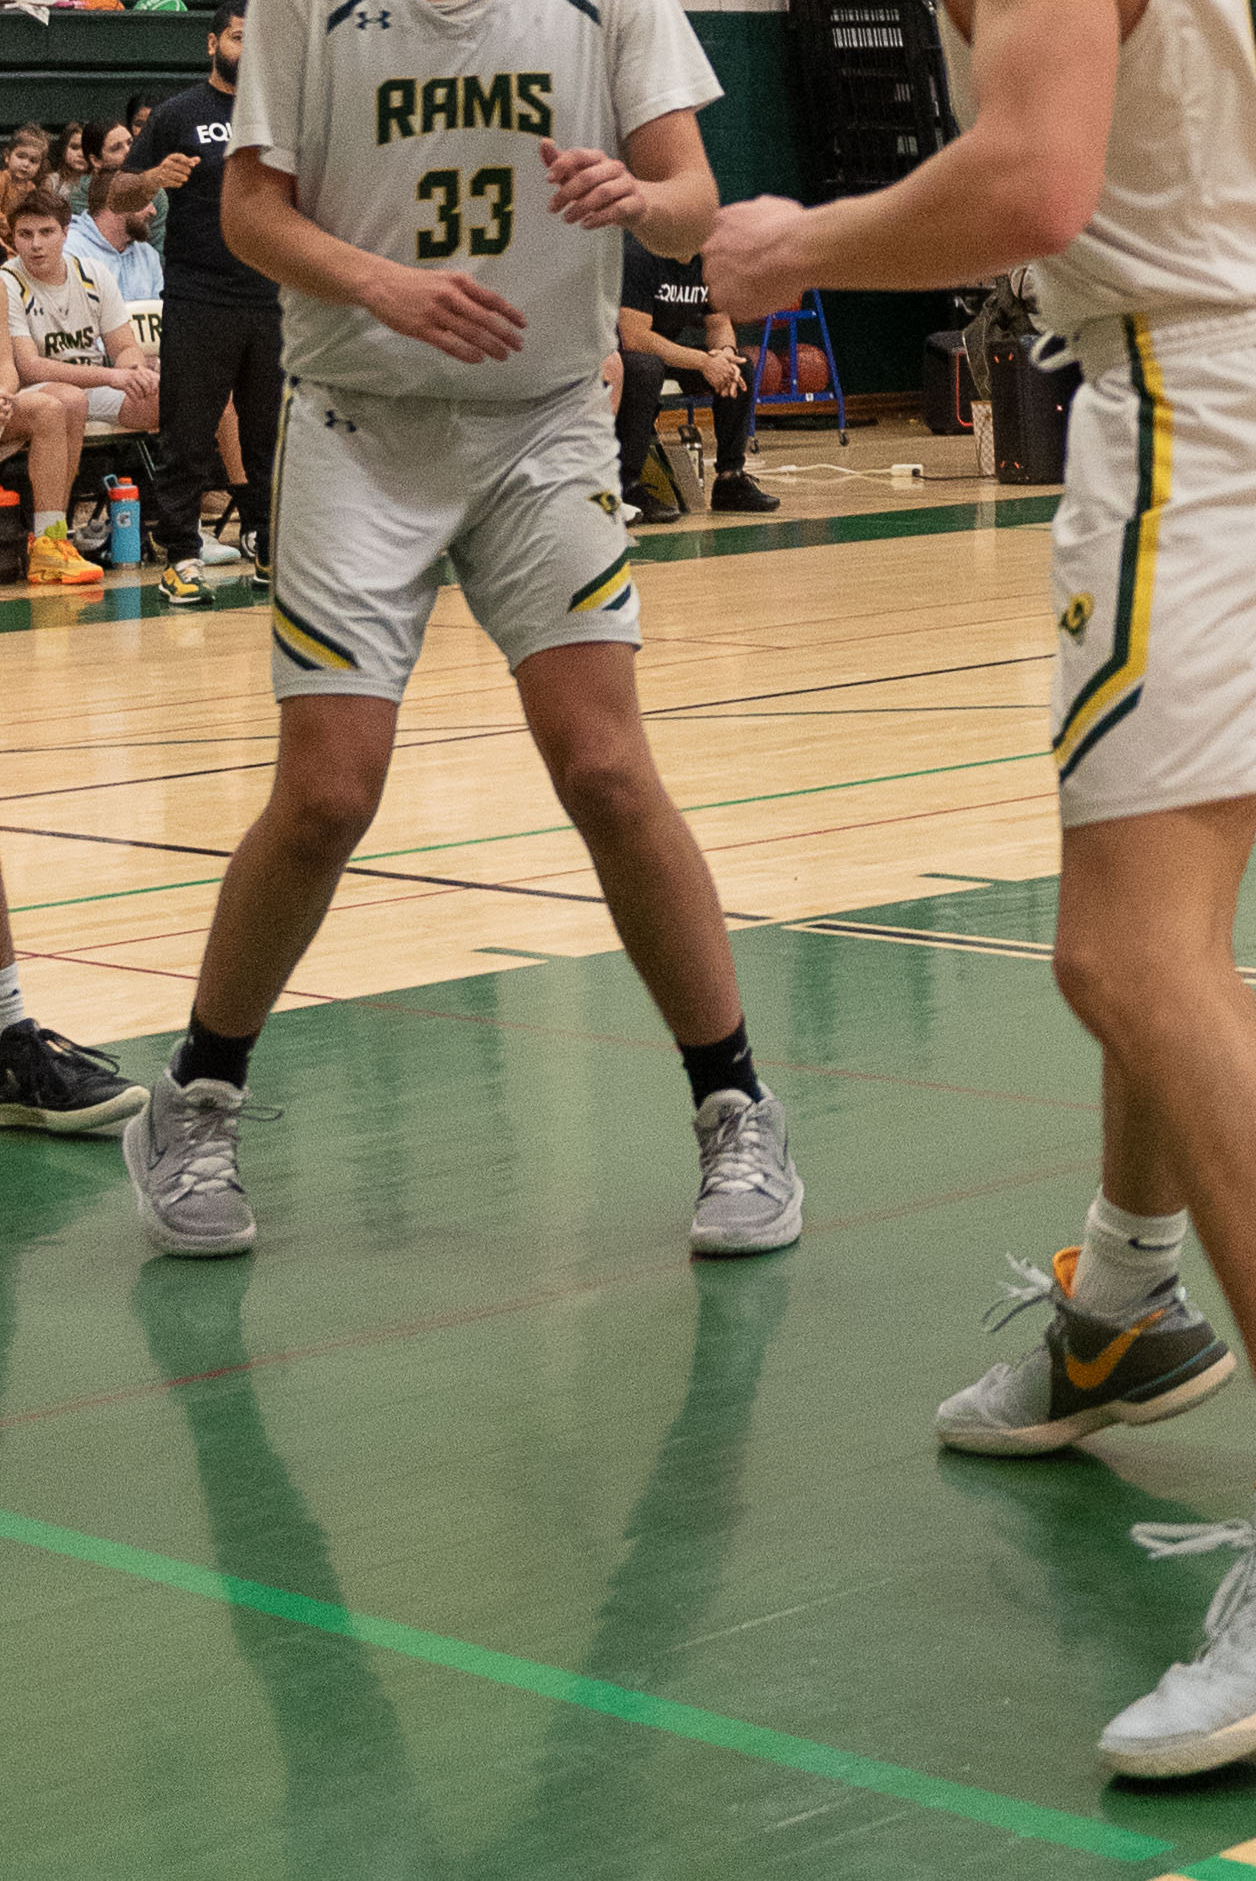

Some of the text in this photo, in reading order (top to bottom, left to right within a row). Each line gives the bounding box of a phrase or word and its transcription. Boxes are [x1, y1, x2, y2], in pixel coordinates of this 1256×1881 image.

[376, 70, 554, 147] RAMS
[415, 165, 515, 262] 33
[44, 326, 94, 357] RAMS
